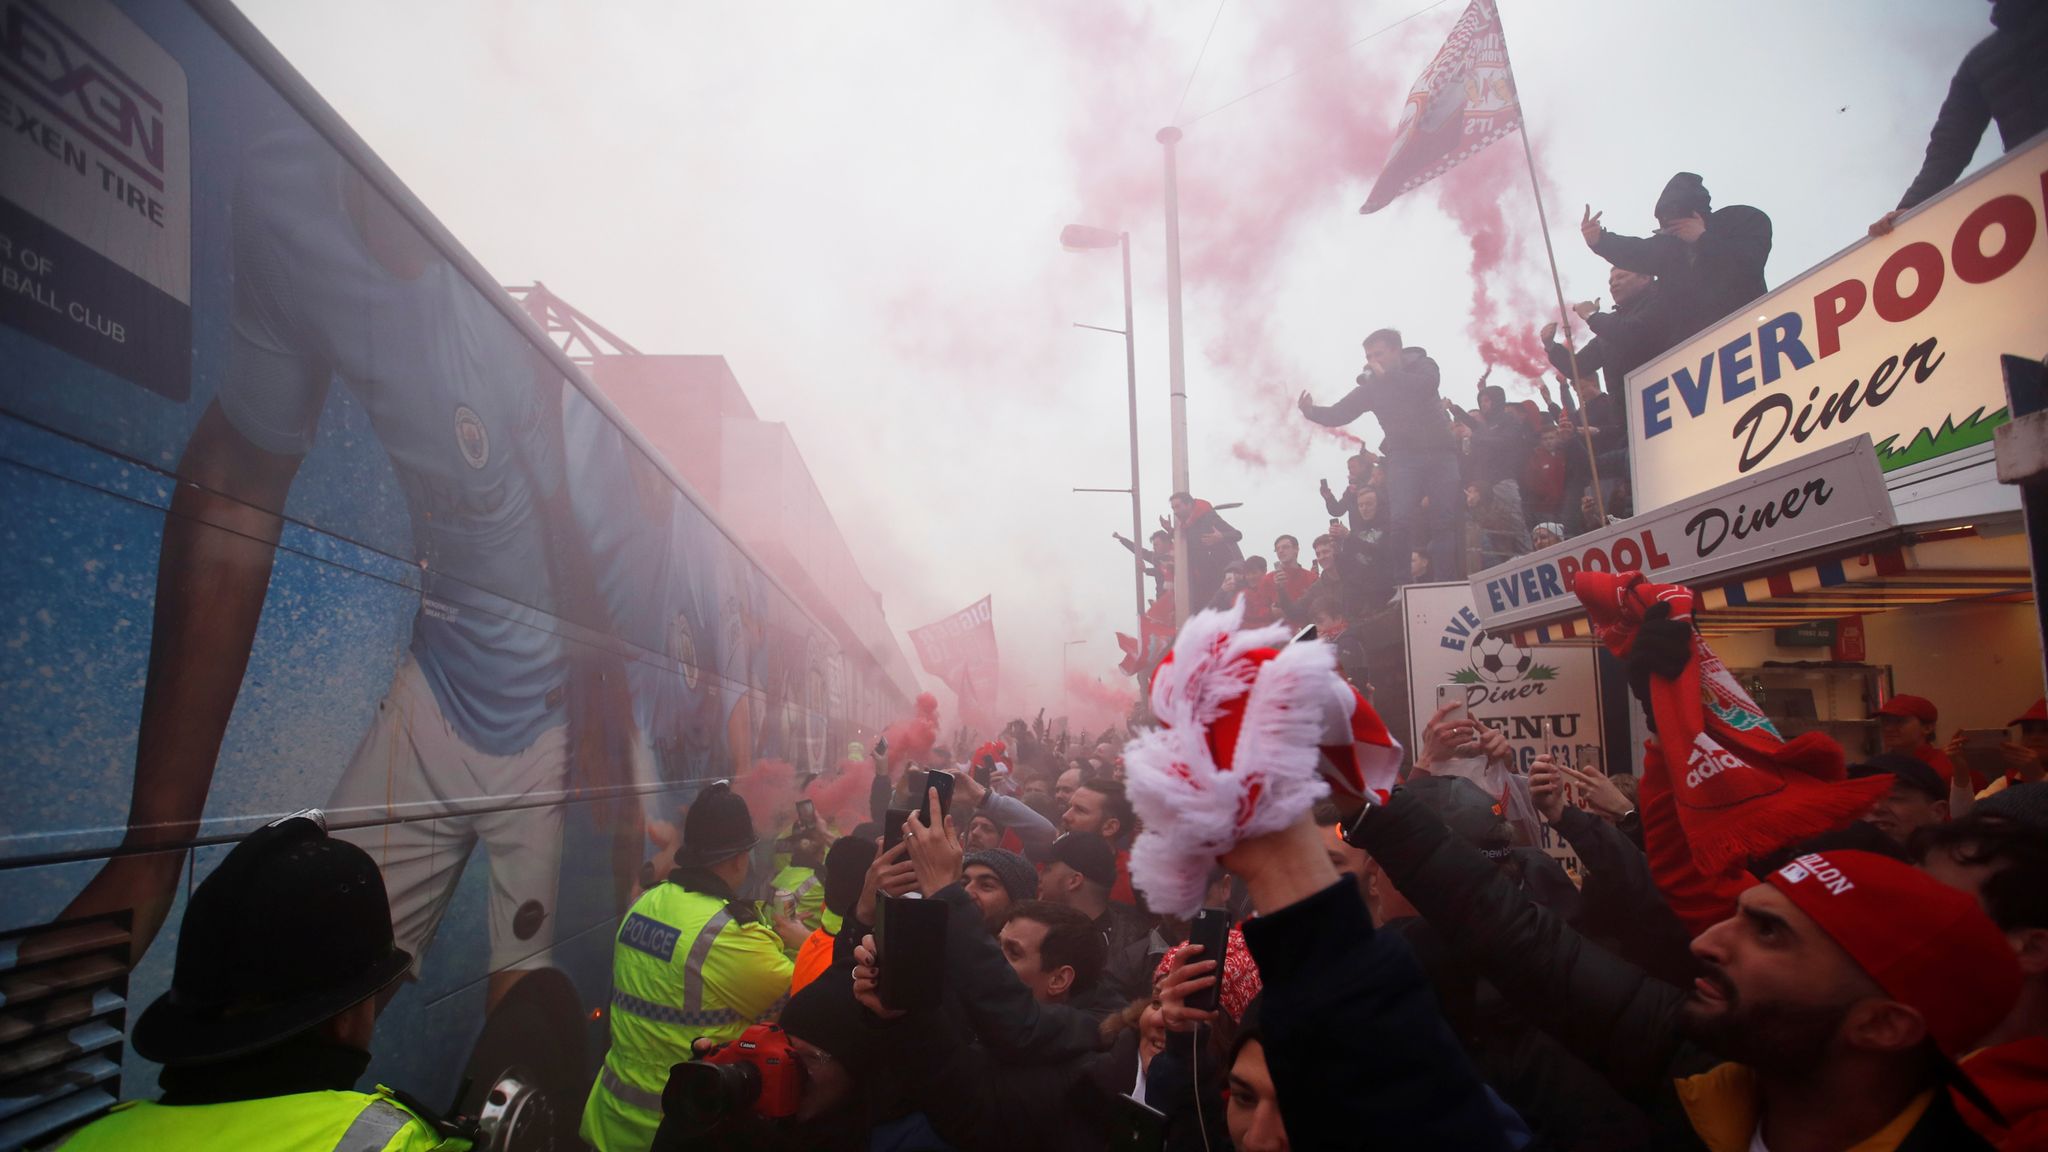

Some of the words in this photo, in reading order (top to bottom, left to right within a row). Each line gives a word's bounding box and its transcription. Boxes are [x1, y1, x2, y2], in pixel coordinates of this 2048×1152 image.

[96, 160, 164, 228] TIRE
[20, 249, 53, 276] OF
[68, 301, 126, 344] CLUB
[1641, 170, 2048, 440] EVERPOO
[1733, 337, 1945, 473] Diner
[1487, 530, 1670, 613] EVERPOOL
[1685, 477, 1833, 558] Diner
[1467, 682, 1547, 708] Diner
[1471, 713, 1581, 742] ENU
[624, 917, 676, 956] POLICE
